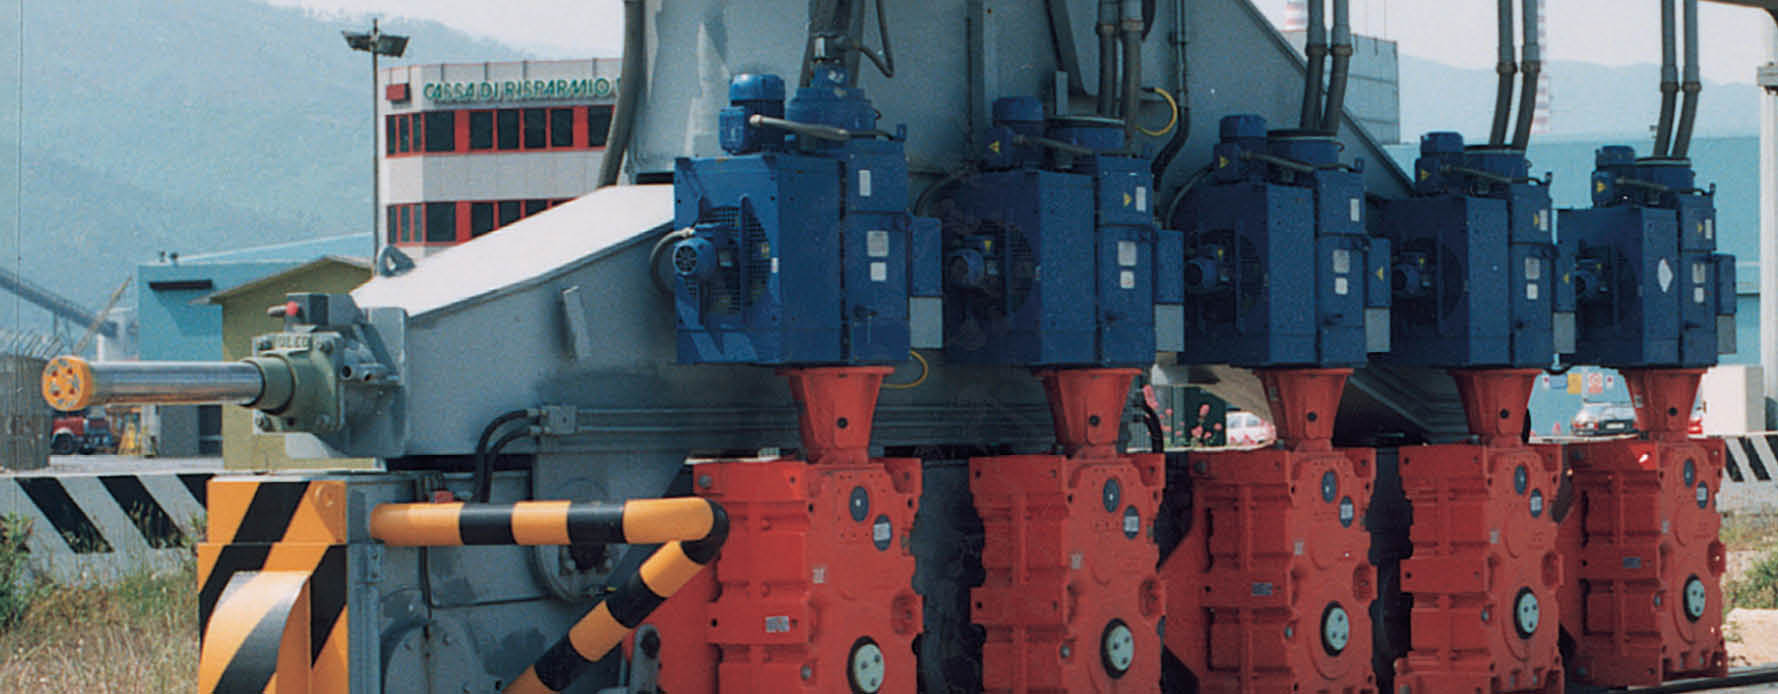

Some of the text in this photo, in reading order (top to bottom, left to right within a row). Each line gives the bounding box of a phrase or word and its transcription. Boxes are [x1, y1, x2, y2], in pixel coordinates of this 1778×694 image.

[423, 82, 474, 100] CASSA
[480, 81, 498, 98] DI
[504, 78, 609, 97] RISPARMIO
